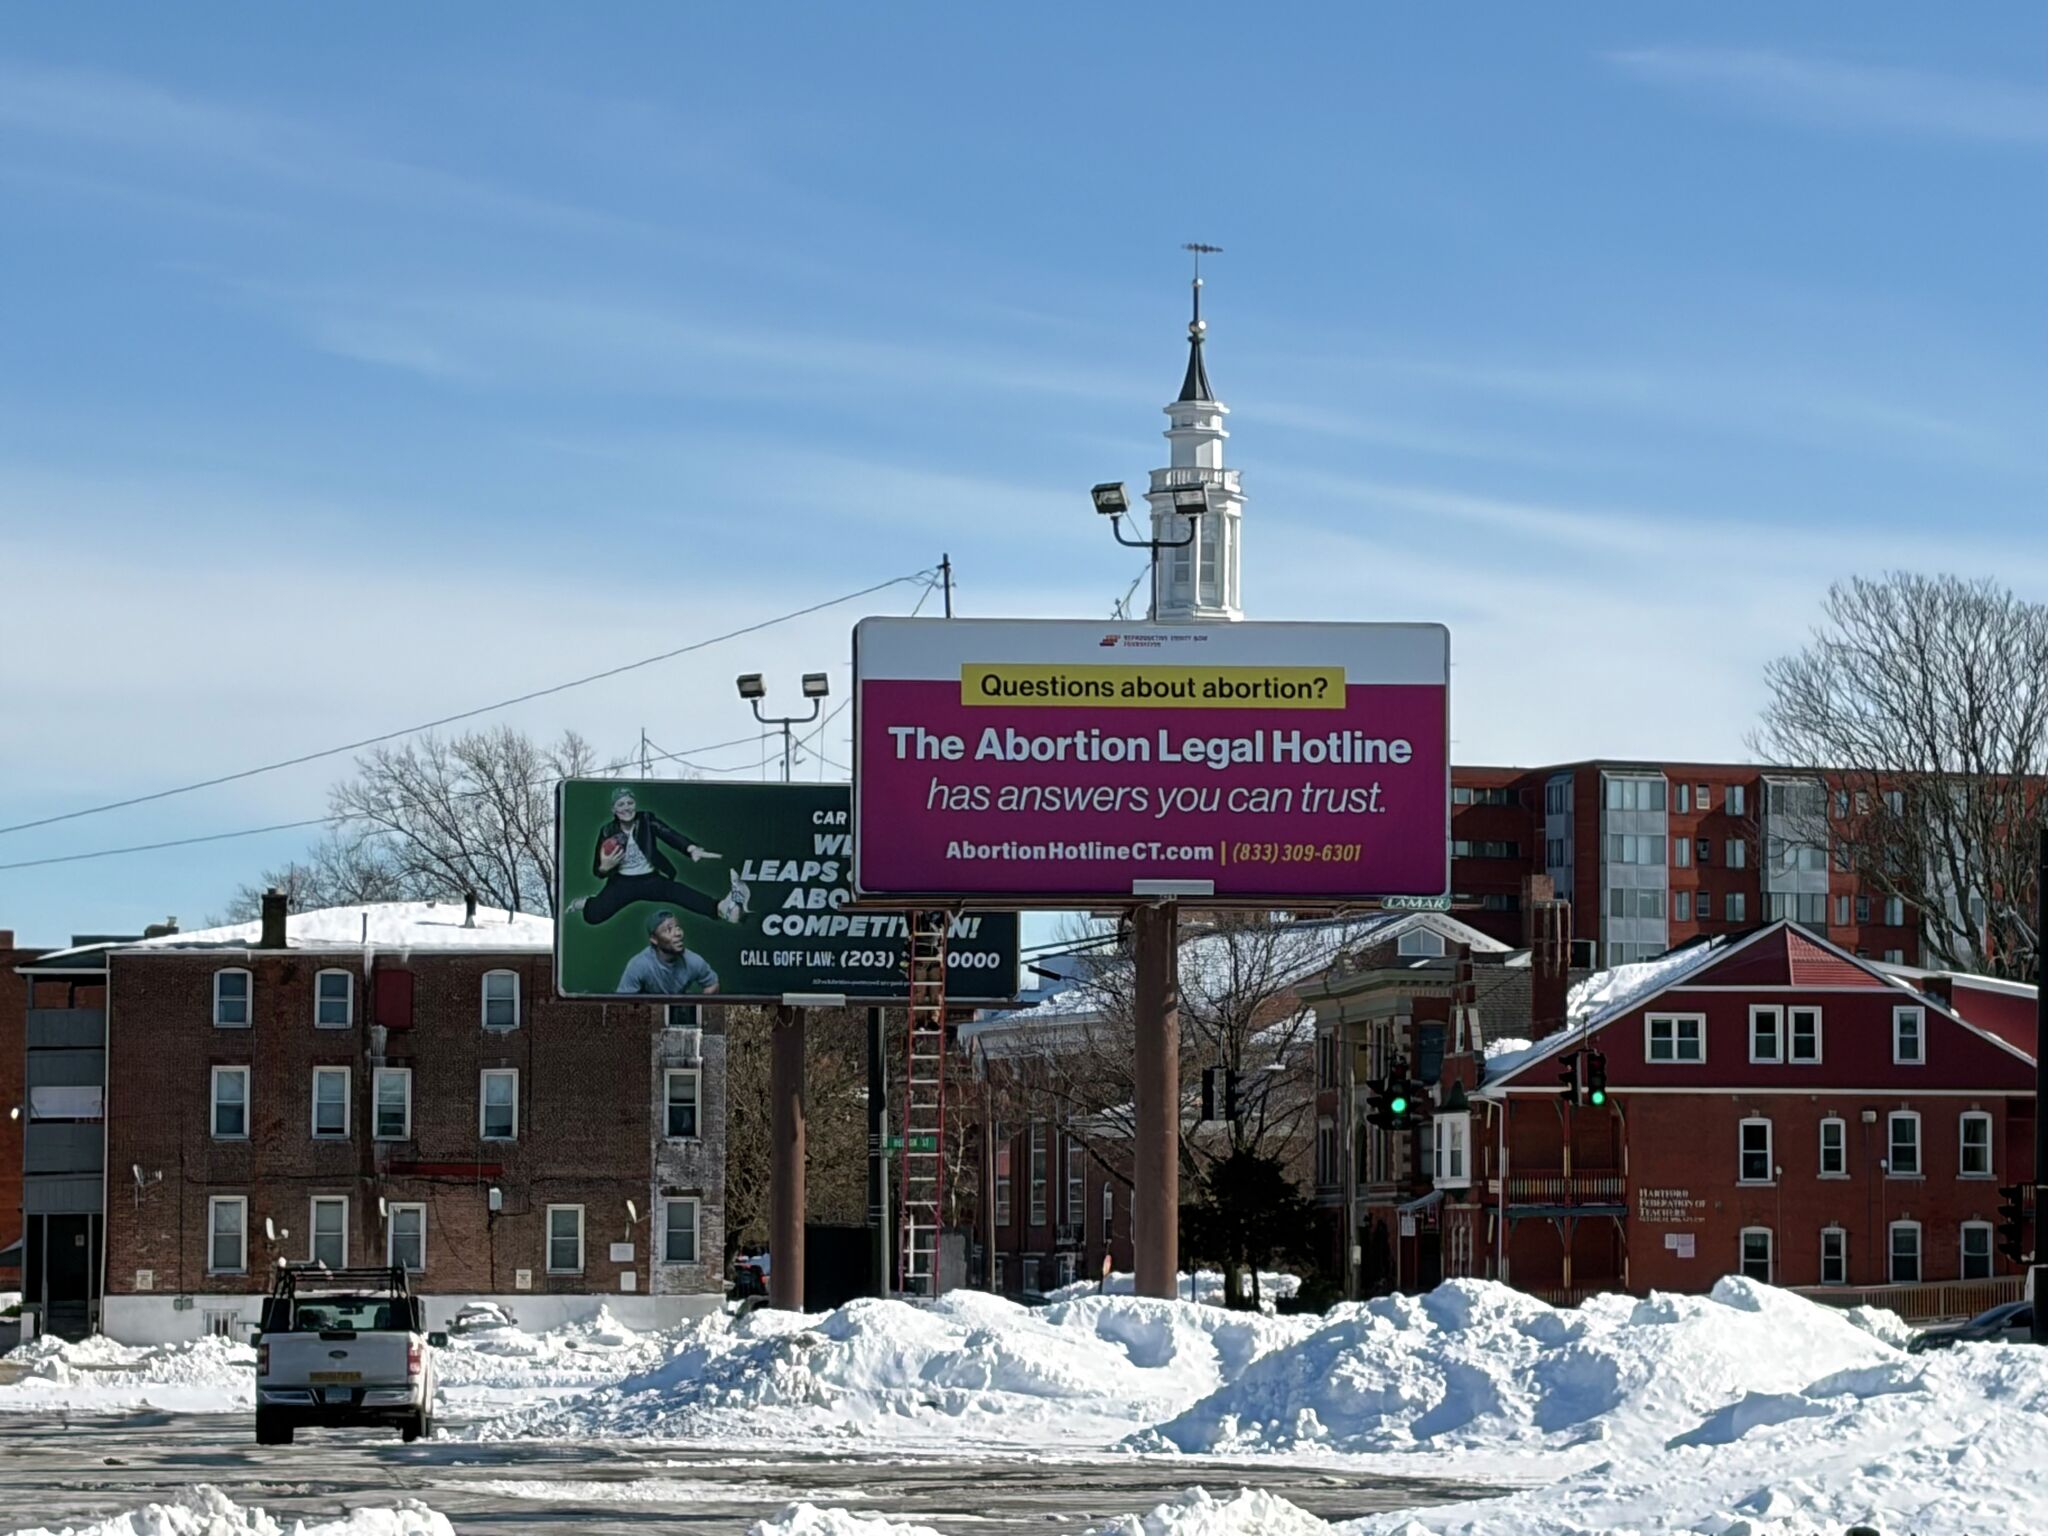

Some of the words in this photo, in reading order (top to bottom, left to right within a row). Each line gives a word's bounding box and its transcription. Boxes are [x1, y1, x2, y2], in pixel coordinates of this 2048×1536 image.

[981, 674, 1115, 697] Questions
[1120, 676, 1196, 698] about
[1202, 677, 1328, 699] abortion?
[888, 727, 965, 760] The
[974, 728, 1149, 761] Abortion
[1158, 729, 1264, 770] Legal
[1272, 730, 1413, 764] Hotline
[927, 777, 991, 811] has
[997, 785, 1149, 812] answers
[1155, 787, 1221, 819] you
[1228, 787, 1293, 813] can
[1301, 782, 1386, 813] trust.
[812, 811, 848, 825] CAR
[946, 841, 1215, 861] AbortionHotlineCT.com
[1232, 842, 1278, 864] (833)
[1281, 844, 1362, 863] 309-6301
[740, 859, 840, 882] LEAPS
[1386, 897, 1446, 911] LAMAR
[762, 914, 982, 938] COMPETITN!
[740, 950, 770, 966] CALL
[773, 950, 804, 966] GOFF
[806, 951, 836, 967] LAW:
[840, 950, 894, 968] (203)
